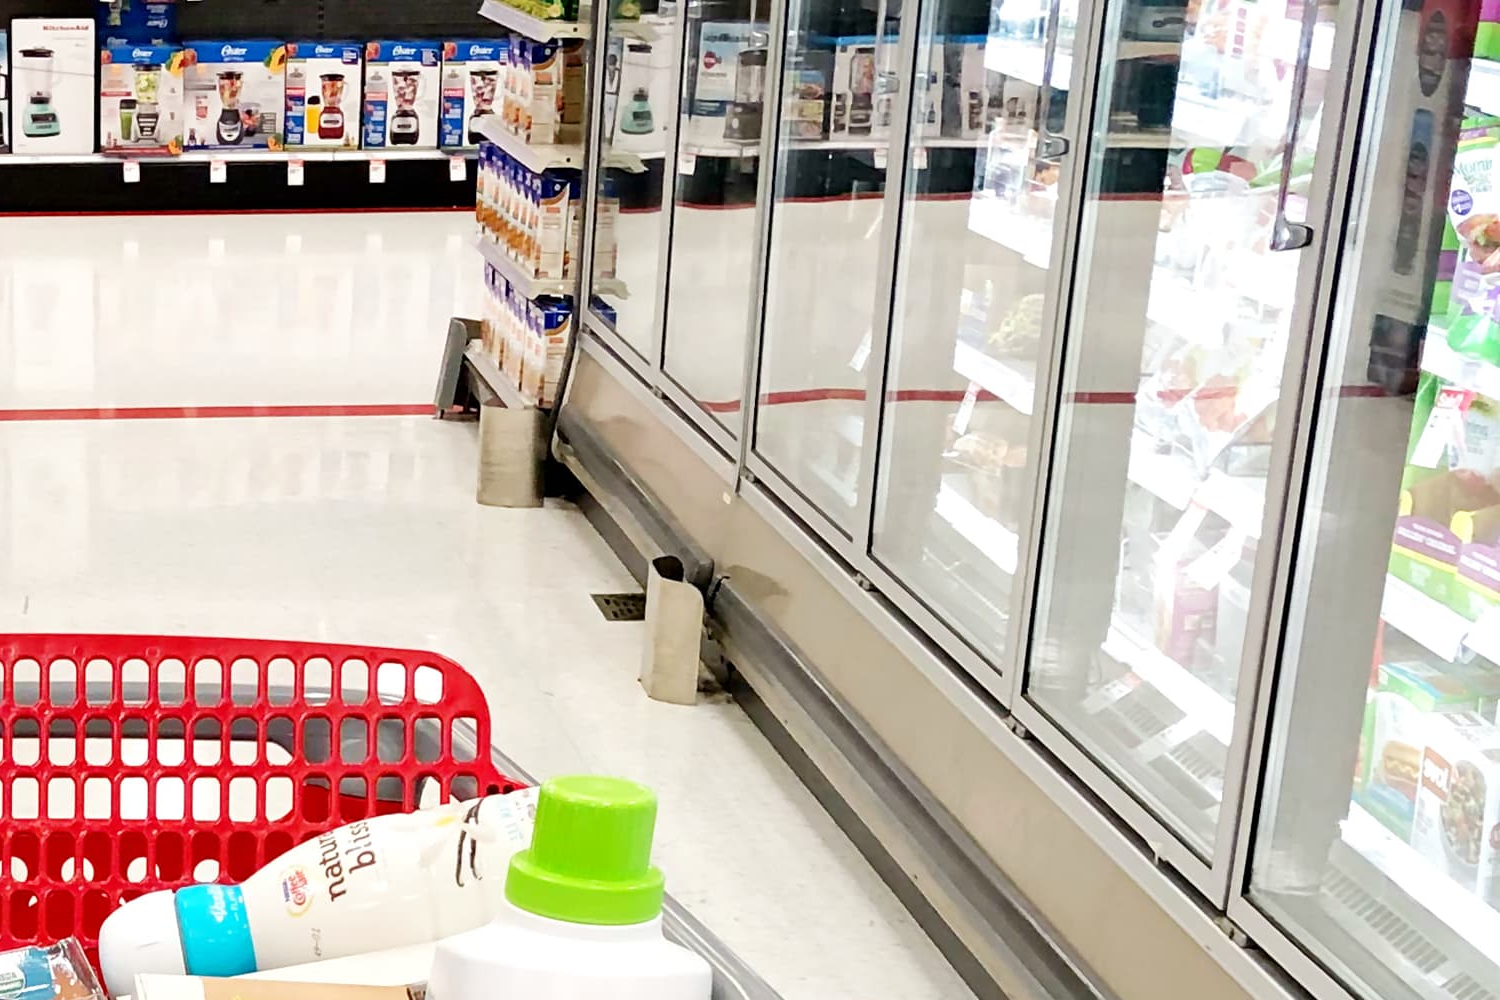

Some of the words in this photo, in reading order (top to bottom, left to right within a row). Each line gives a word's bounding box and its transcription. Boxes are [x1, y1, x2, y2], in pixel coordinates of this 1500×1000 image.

[132, 48, 153, 58] Oster
[221, 45, 247, 56] Oster
[392, 45, 416, 56] Oster
[470, 45, 493, 56] Oster
